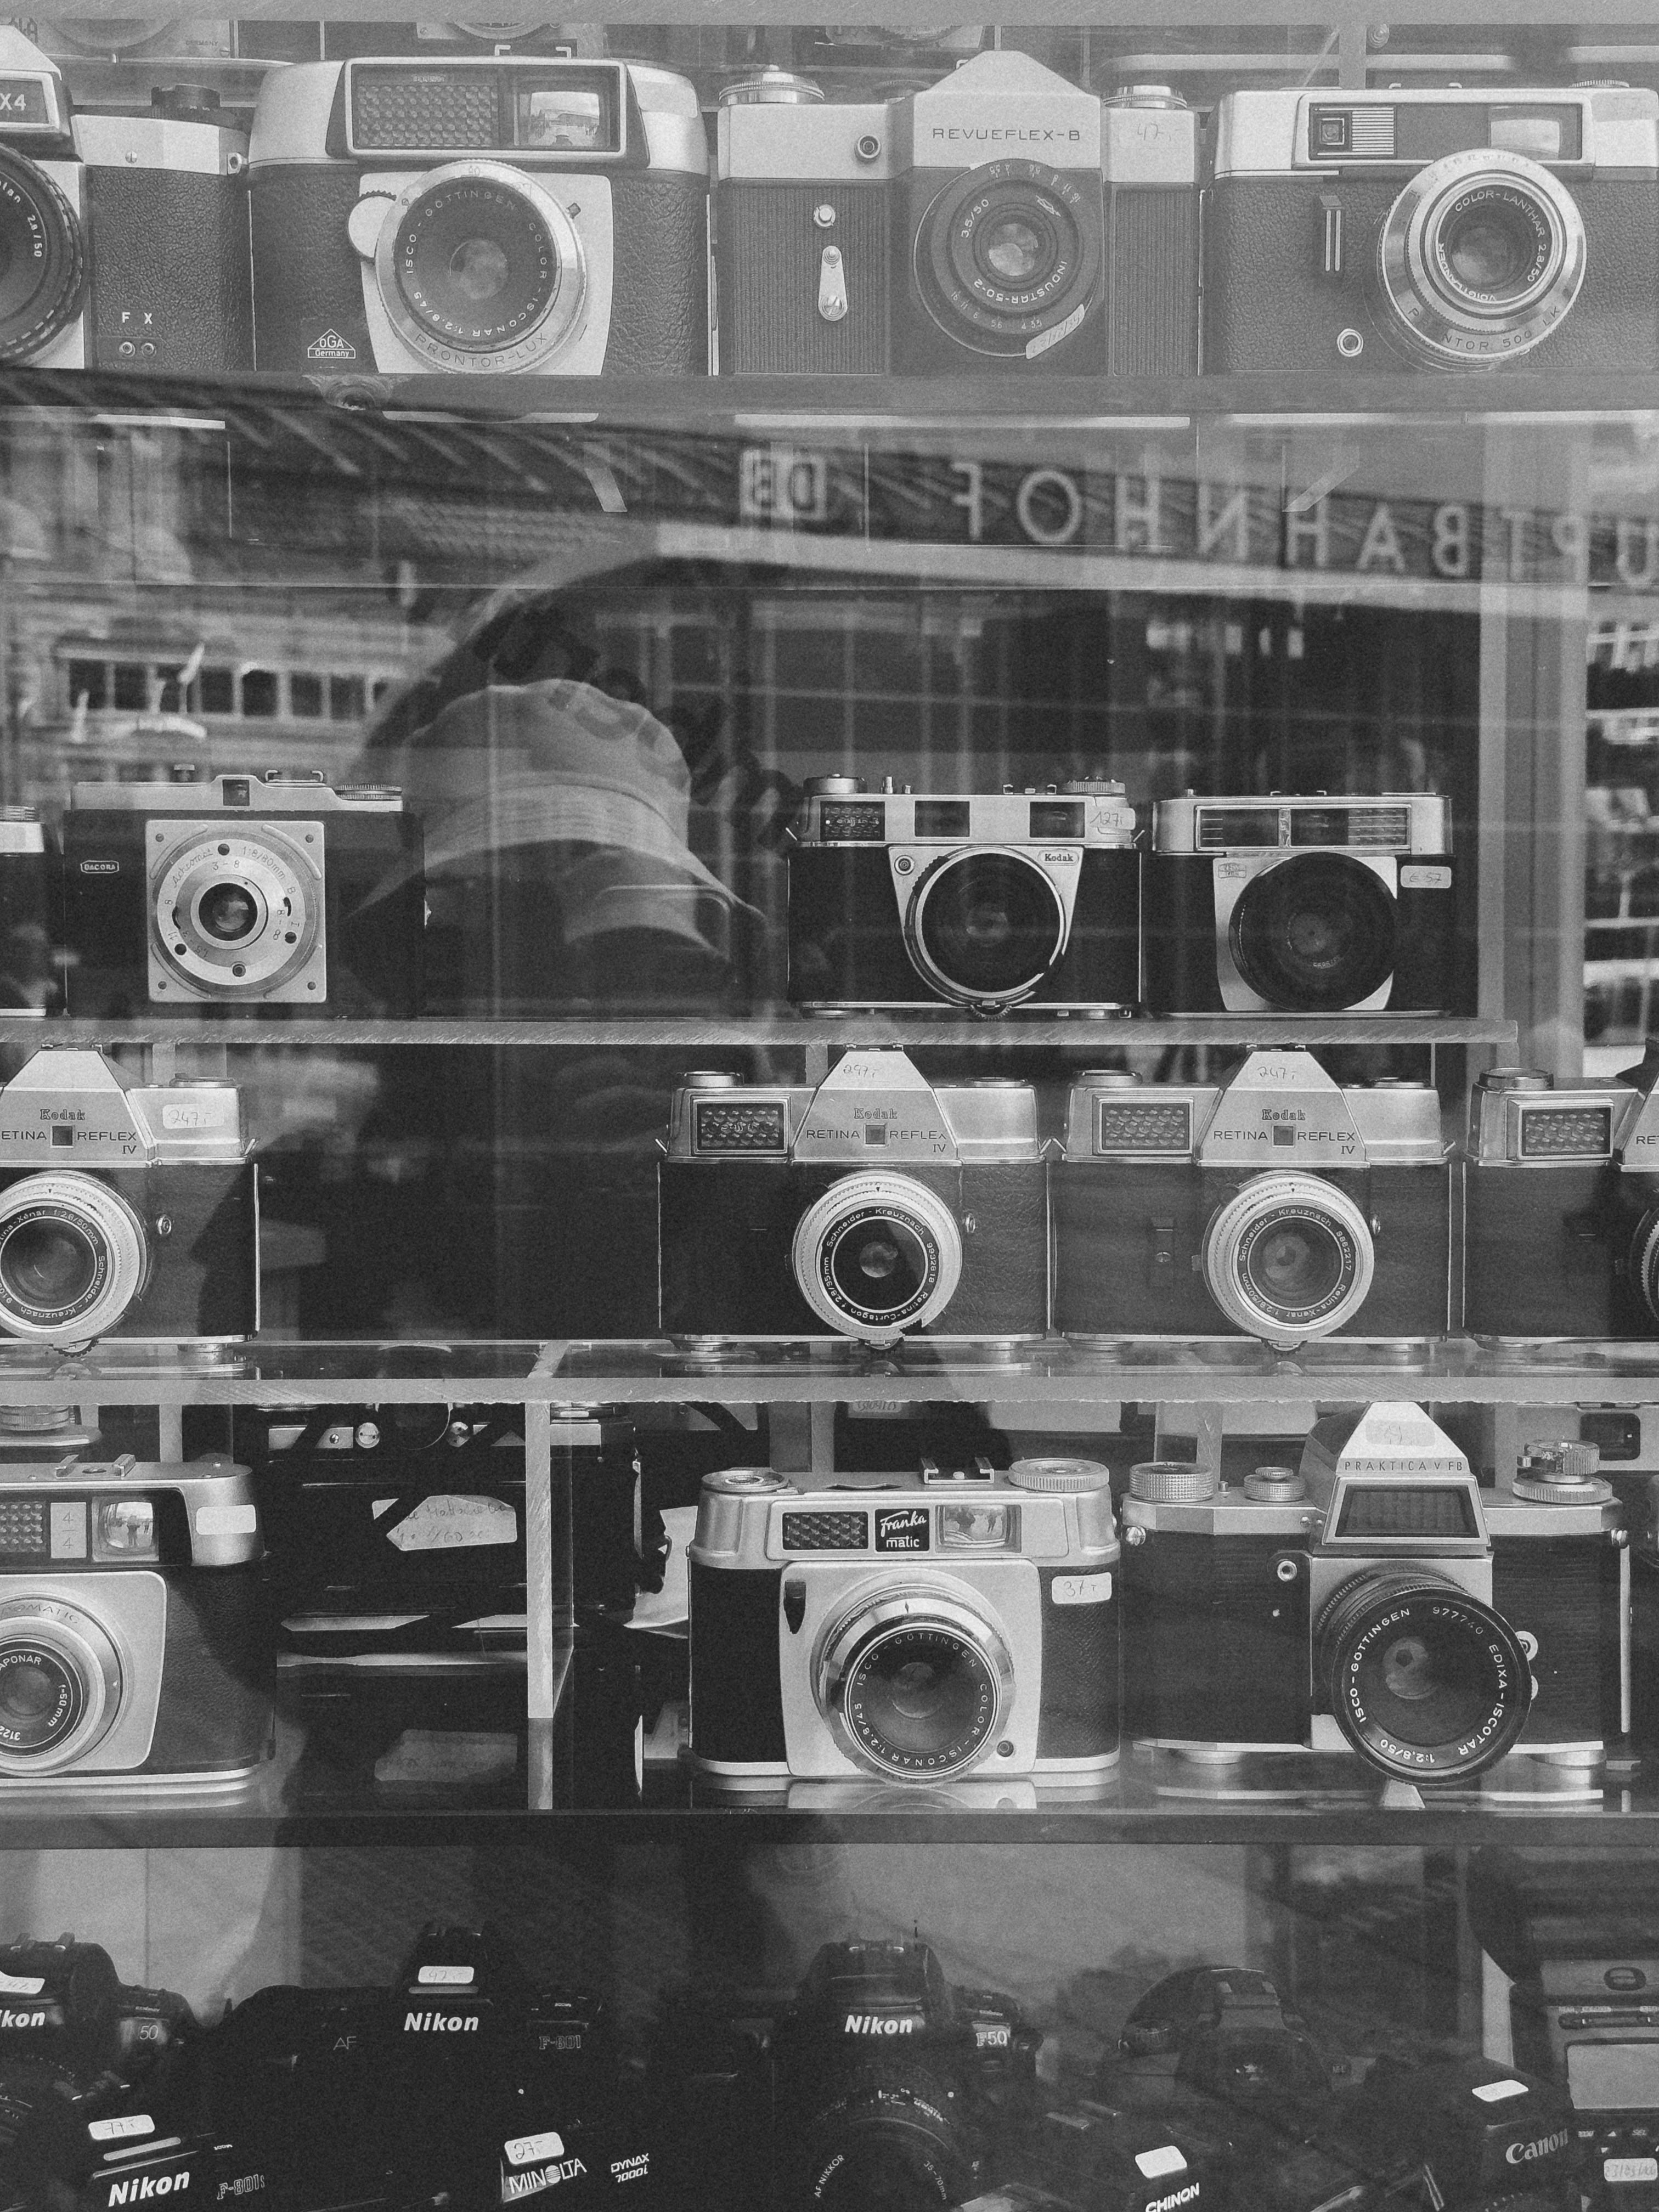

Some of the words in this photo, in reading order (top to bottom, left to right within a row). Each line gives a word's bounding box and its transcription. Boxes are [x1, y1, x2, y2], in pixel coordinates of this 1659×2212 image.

[932, 128, 1080, 141] REVUEFLEX-B
[1455, 190, 1545, 238] COLOR-LANTHAR
[974, 260, 1068, 304] INDUSTAR-50-2
[122, 313, 131, 323] F
[144, 313, 153, 324] X
[1503, 330, 1532, 347] 500
[315, 349, 349, 358] Germany
[415, 332, 548, 368] PRONTOR-LUX
[1044, 851, 1074, 862] Kodak
[40, 1109, 86, 1120] Kodak
[854, 1108, 898, 1119] Kodak
[1262, 1109, 1306, 1121] Kodak
[1, 1131, 47, 1141] ETINA
[77, 1131, 137, 1141] REFLEX
[806, 1130, 860, 1139] RETINA
[1213, 1130, 1268, 1140] RETINA
[1297, 1131, 1355, 1142] REFLEX
[122, 1146, 137, 1155] IV
[933, 1144, 946, 1153] IV
[1341, 1146, 1356, 1154] IV
[827, 1211, 865, 1247] Schneider
[876, 1208, 925, 1235] Kreuznach
[1239, 1217, 1268, 1262] Schneider
[1279, 1208, 1331, 1227] Kreuznach
[84, 1255, 105, 1304] Schneider
[20, 1306, 77, 1318] Kreuznach
[1345, 1461, 1427, 1471] PRAKTICA
[879, 1510, 927, 1537] Franka
[886, 1535, 919, 1548] matic
[0, 2010, 46, 2028] kon
[404, 2012, 479, 2032] Nikon
[844, 2015, 912, 2034] Nikon
[333, 2035, 357, 2050] AF
[539, 2035, 581, 2050] F-801
[976, 2030, 1008, 2047] F50
[1505, 2128, 1569, 2164] Canon
[610, 2153, 650, 2174] DYNAX
[819, 2154, 845, 2185] NIKKOR
[508, 2158, 588, 2194] MINOLTA
[615, 2164, 648, 2183] 7000i
[108, 2171, 190, 2207] Nikon
[1146, 2182, 1200, 2212] CHINON
